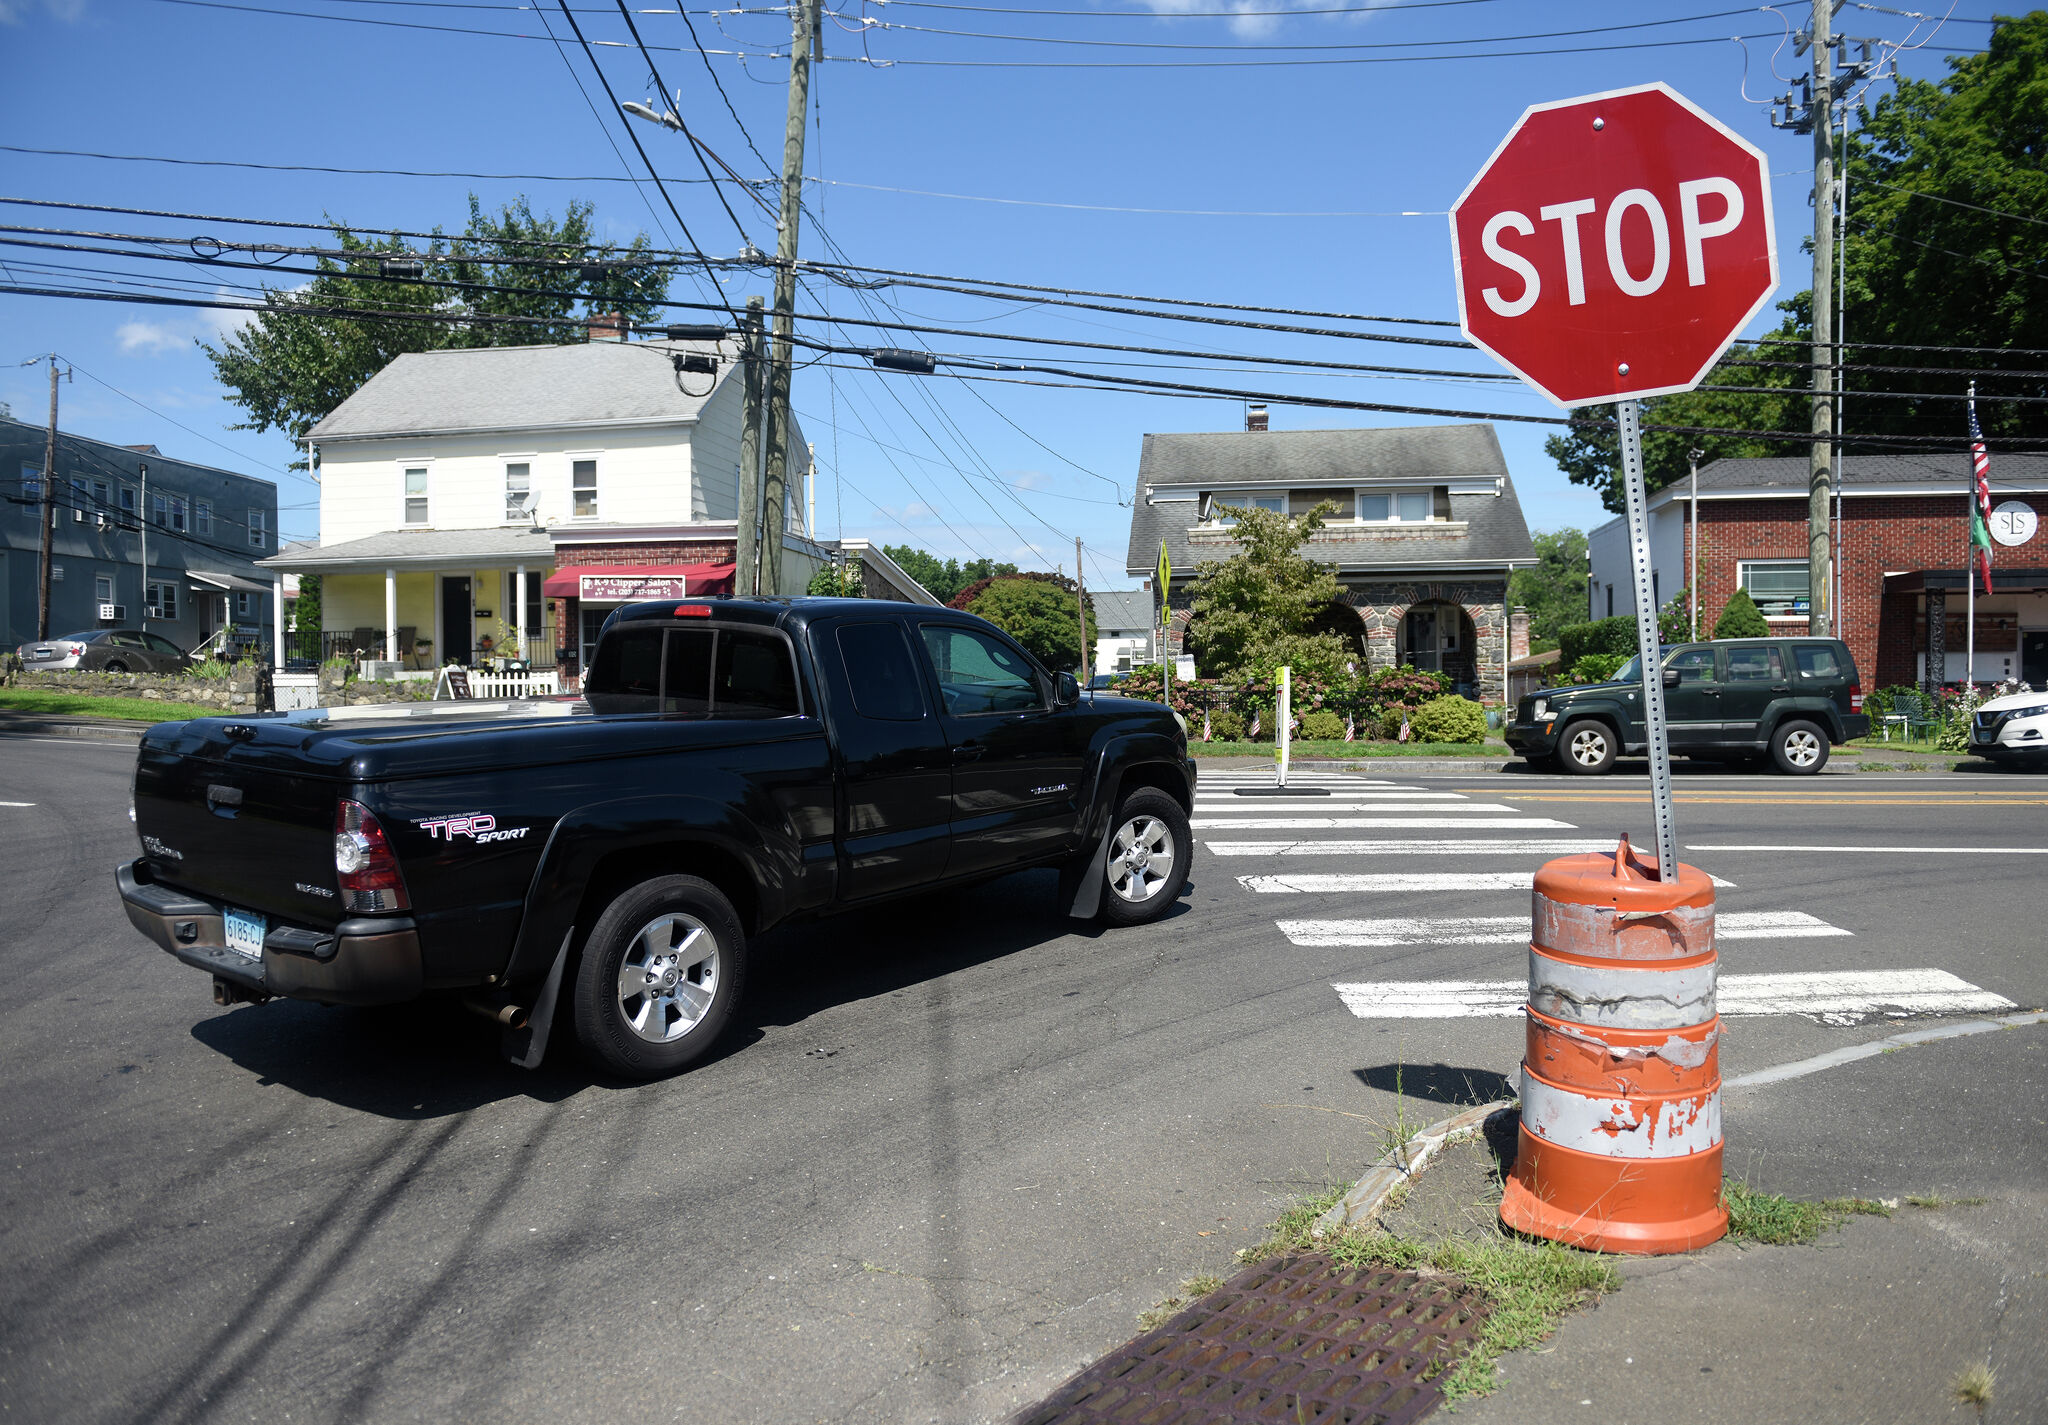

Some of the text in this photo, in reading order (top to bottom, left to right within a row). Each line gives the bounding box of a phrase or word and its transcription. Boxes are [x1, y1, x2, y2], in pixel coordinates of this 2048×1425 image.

[1481, 177, 1745, 318] STOP
[610, 578, 645, 588] Clippers
[448, 811, 481, 819] DEVELOPMENT
[420, 814, 496, 841] TRD
[476, 827, 530, 844] SPORT
